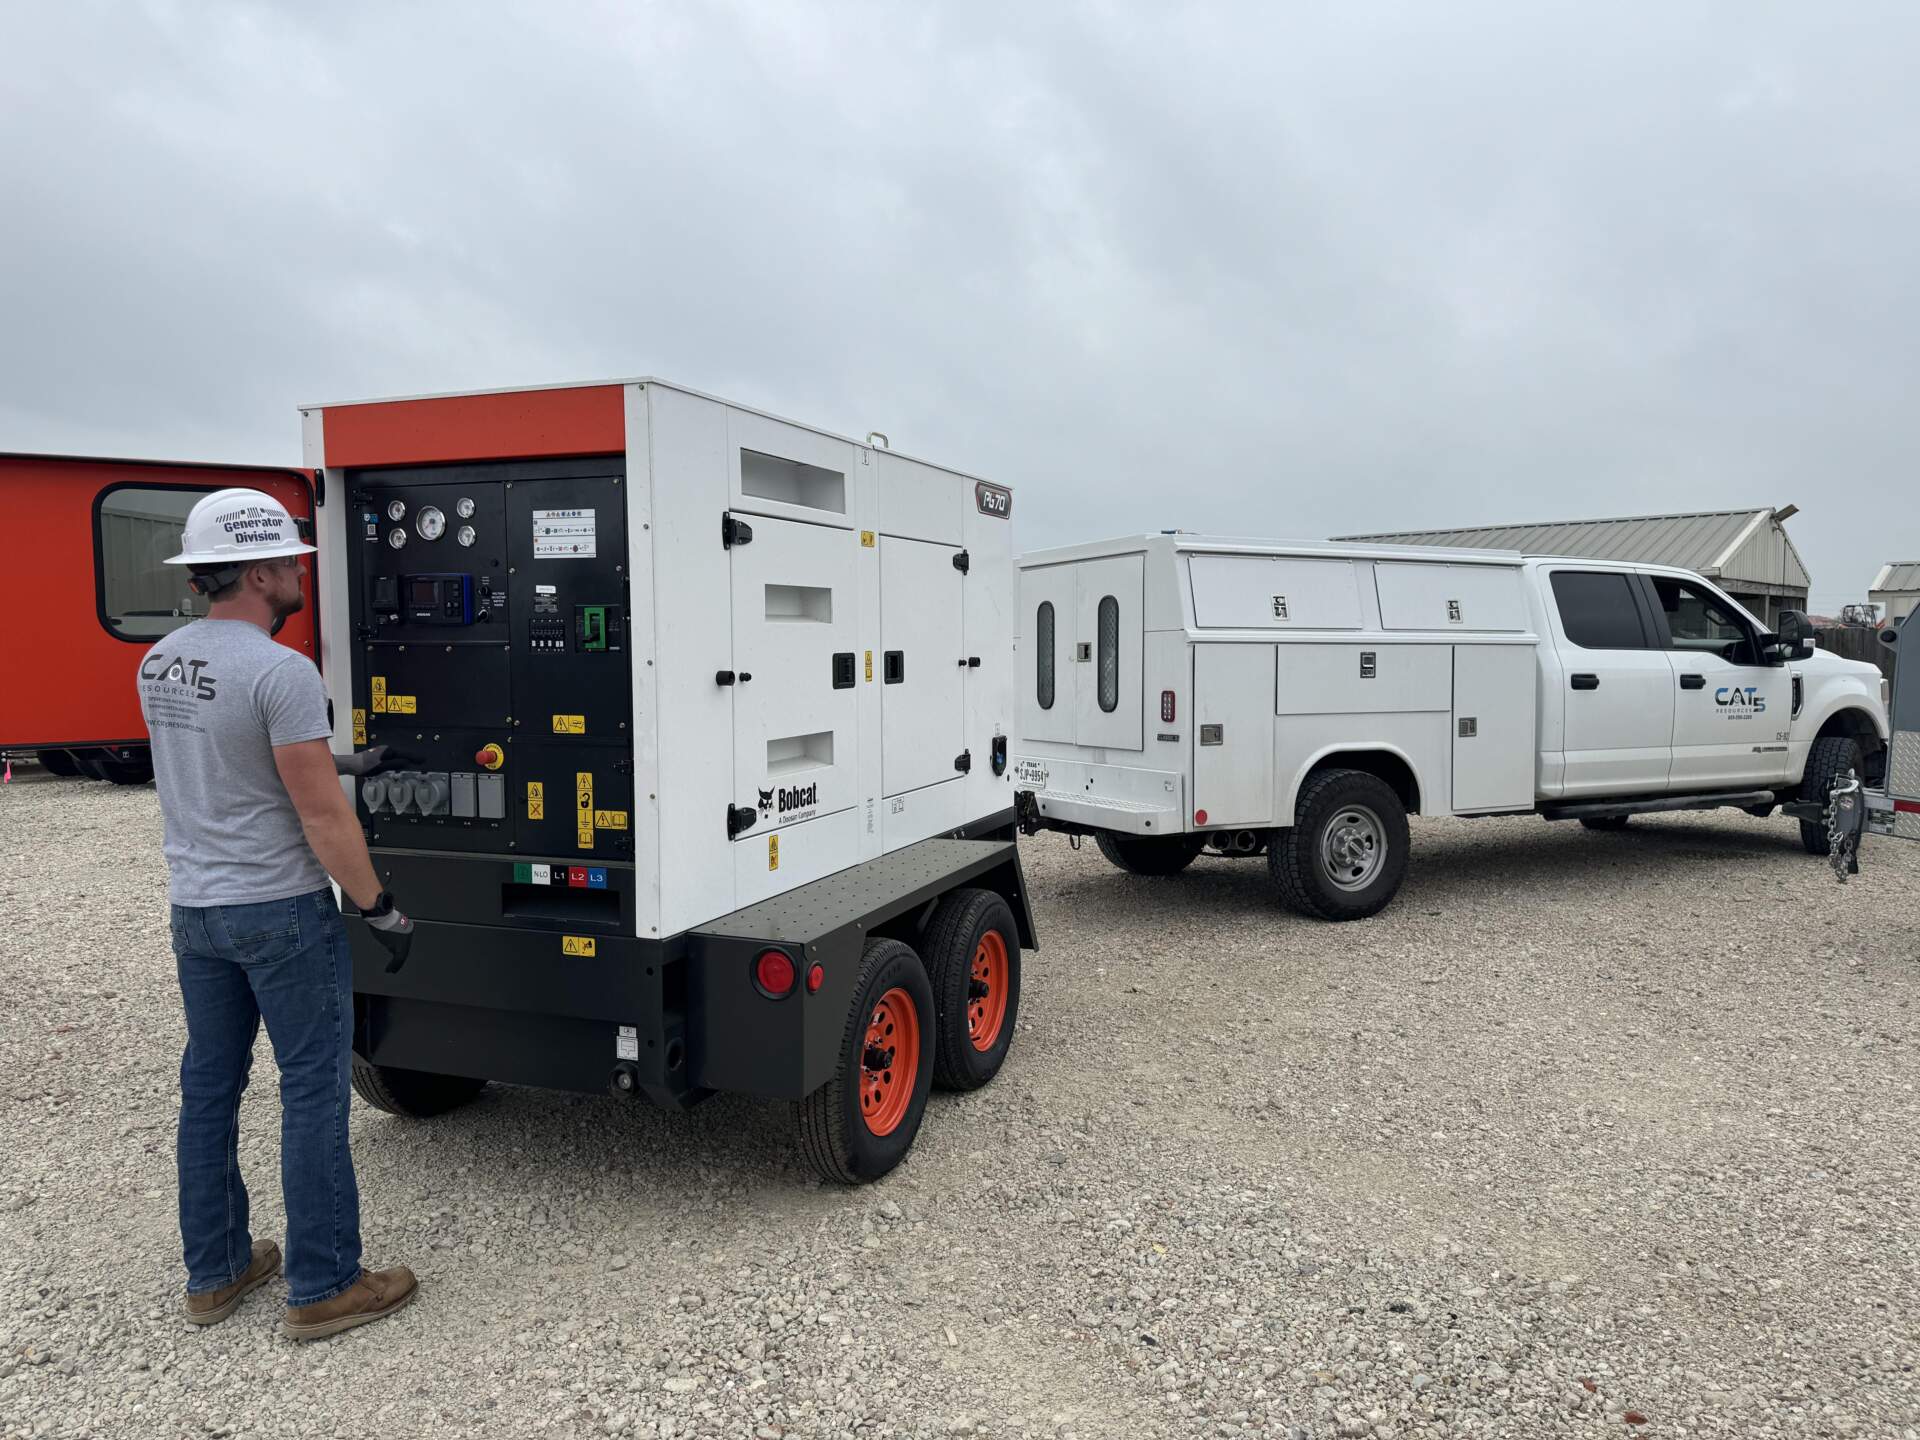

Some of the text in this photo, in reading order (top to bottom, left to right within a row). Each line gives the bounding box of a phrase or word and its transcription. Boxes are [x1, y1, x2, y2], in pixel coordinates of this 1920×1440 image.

[224, 518, 283, 533] Generator
[235, 530, 281, 543] Division
[778, 781, 817, 813] Bobcat
[798, 809, 817, 819] Company
[554, 871, 565, 880] L1
[571, 873, 585, 881] L2
[590, 874, 603, 882] L3
